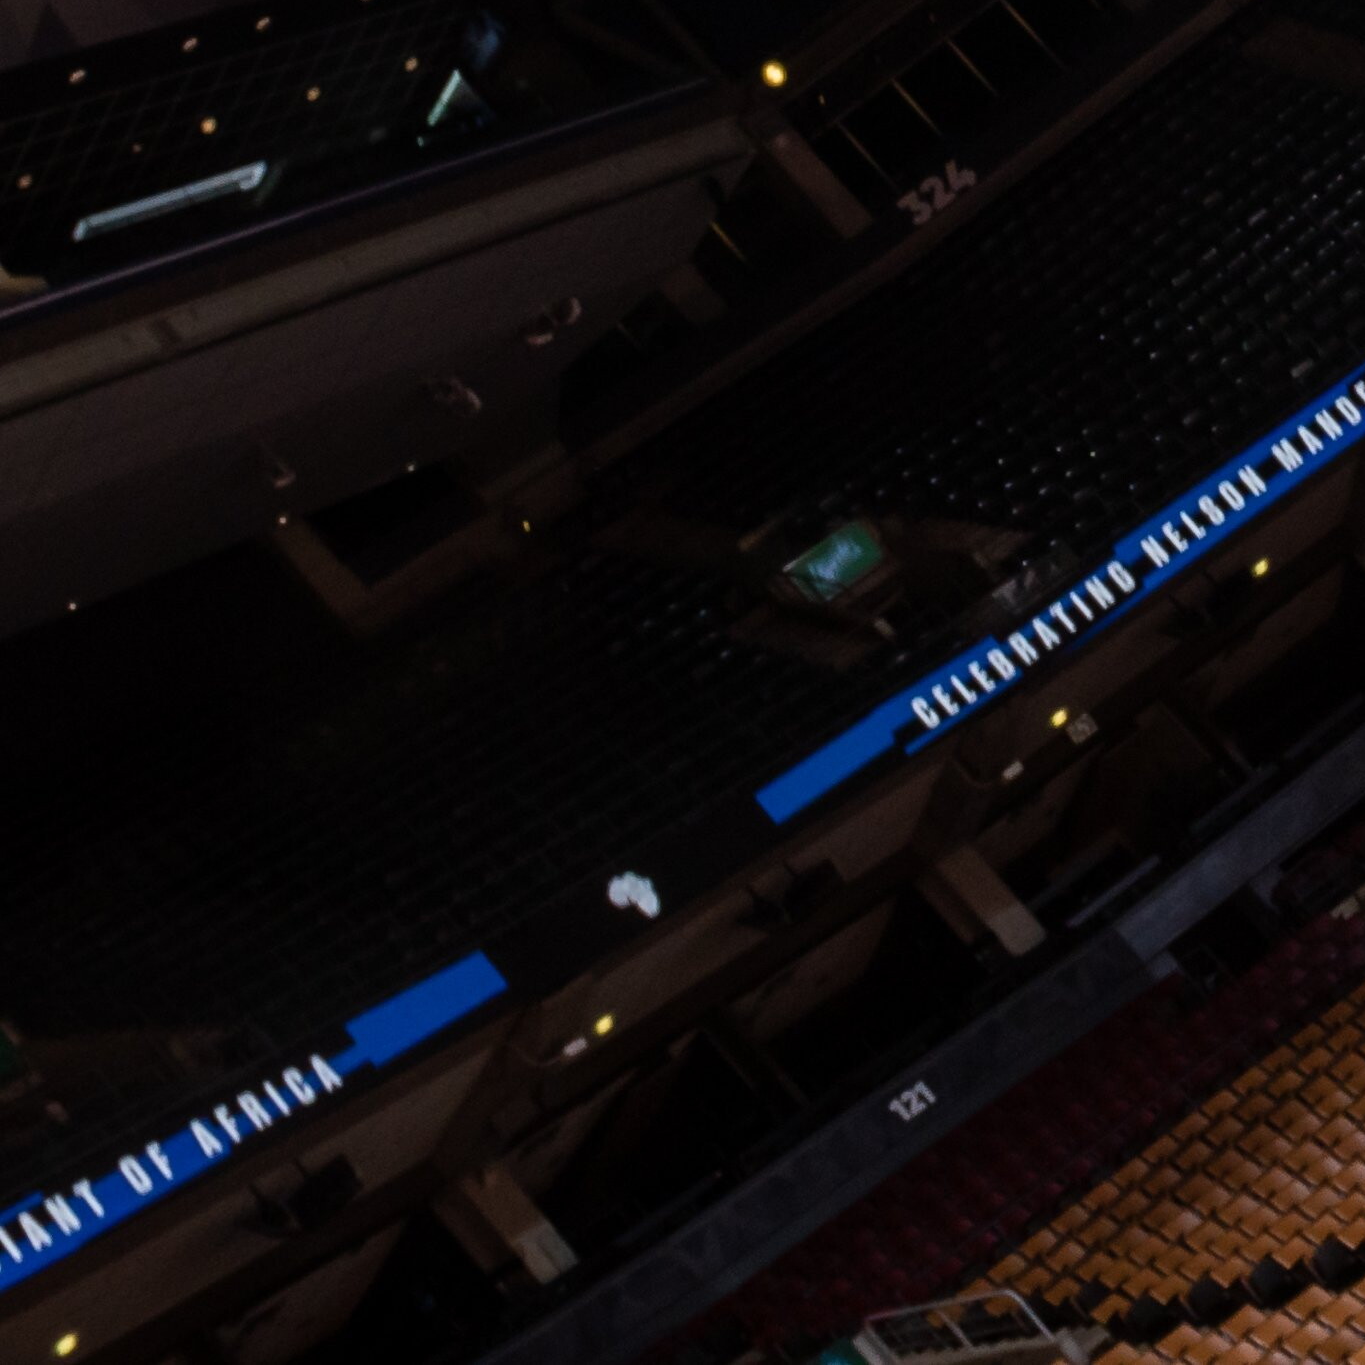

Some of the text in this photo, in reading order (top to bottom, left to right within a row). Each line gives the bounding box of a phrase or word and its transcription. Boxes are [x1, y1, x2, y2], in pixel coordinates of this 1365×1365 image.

[895, 158, 977, 227] 324
[910, 559, 1137, 730] CELEBRATING
[1139, 463, 1268, 569] NELSON
[0, 1052, 344, 1272] IANT OF AFRICA
[888, 1080, 937, 1122] 121
